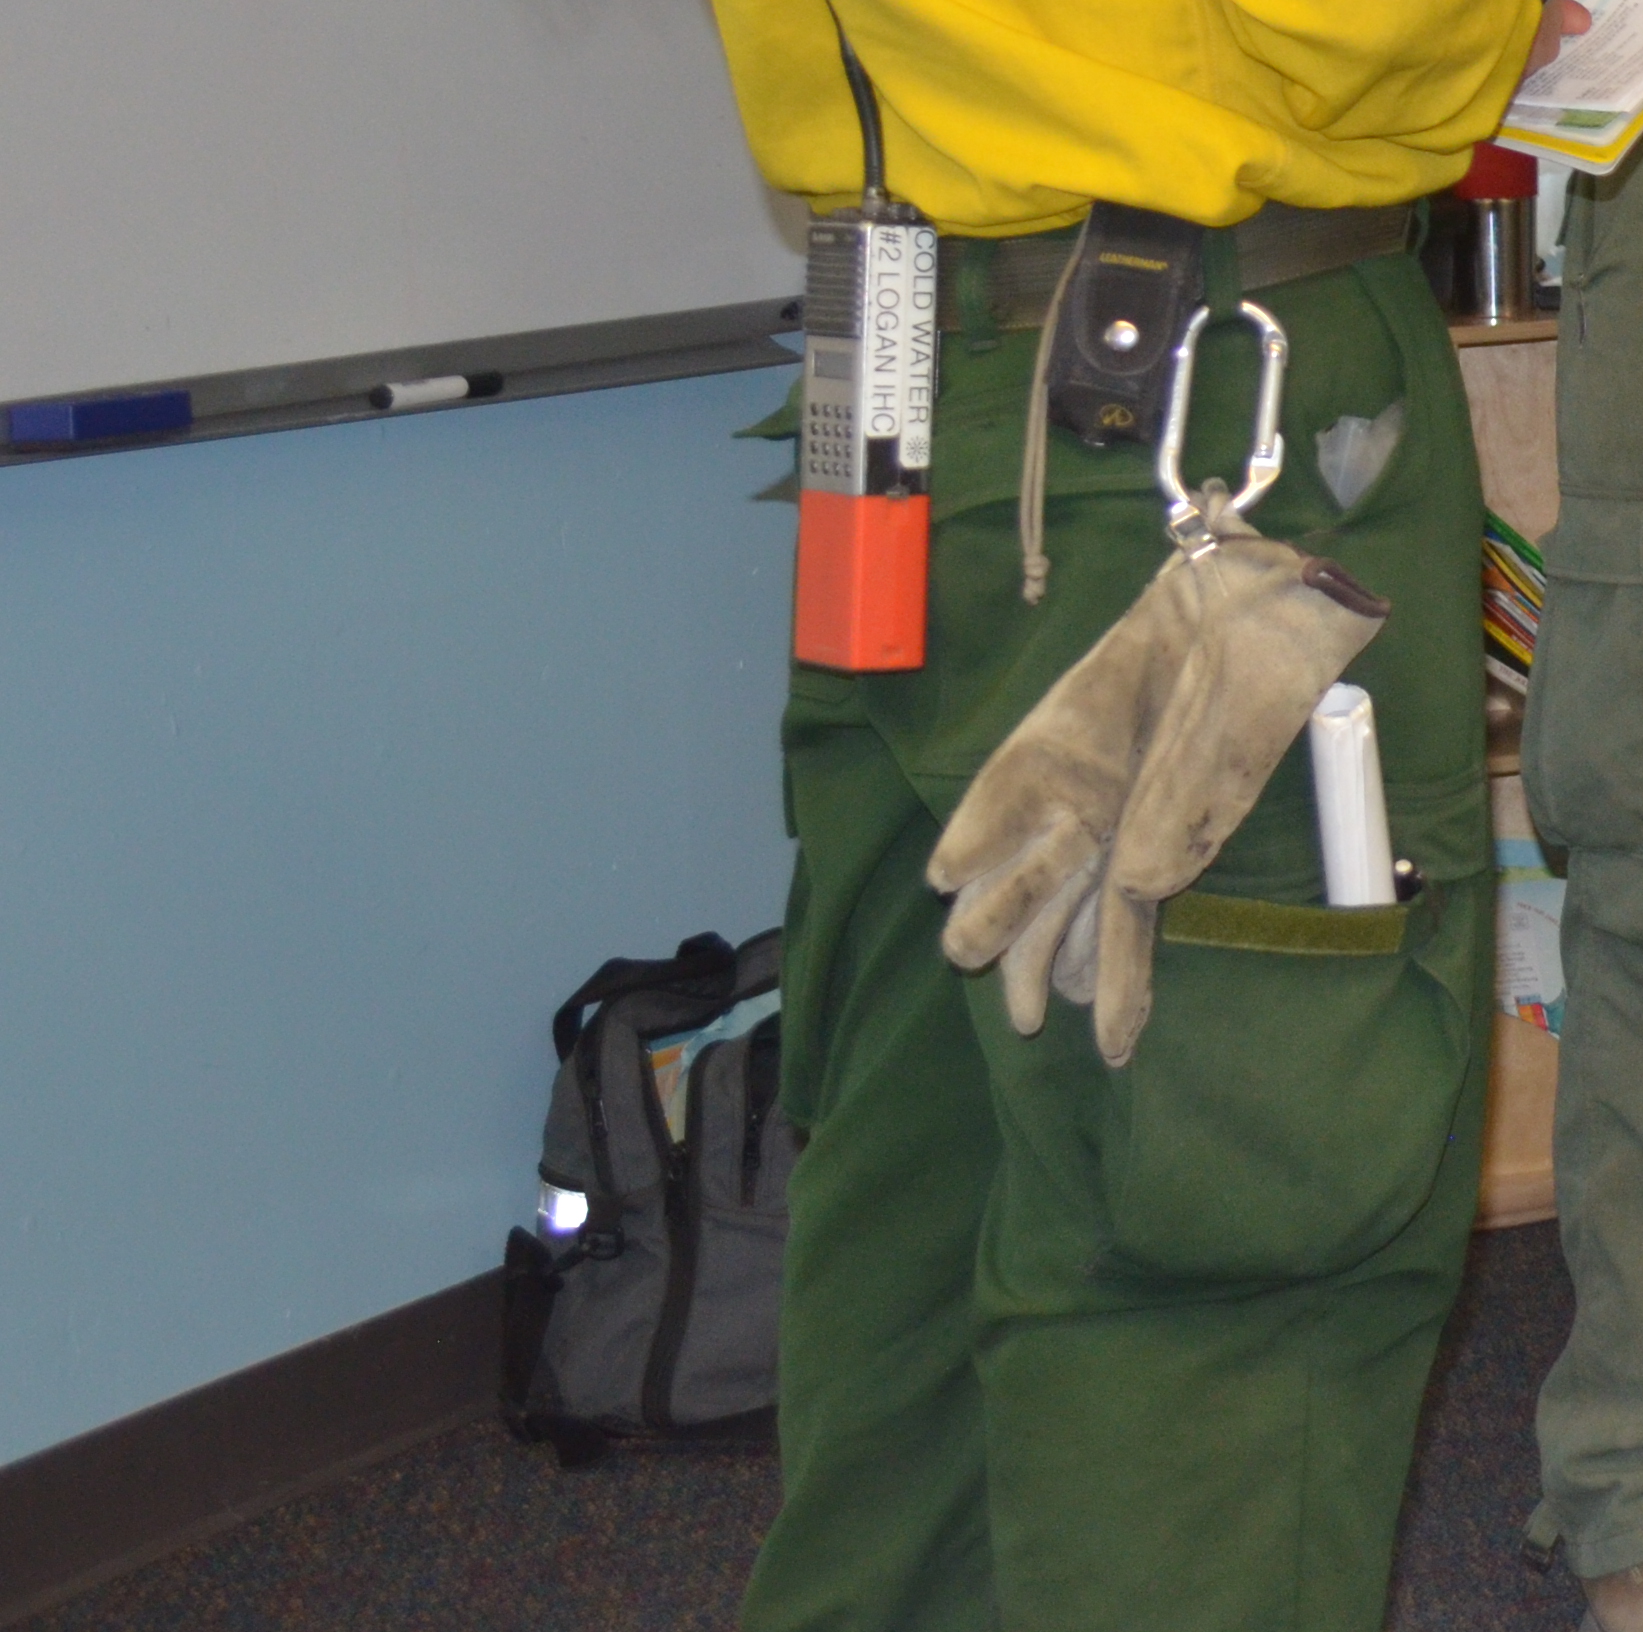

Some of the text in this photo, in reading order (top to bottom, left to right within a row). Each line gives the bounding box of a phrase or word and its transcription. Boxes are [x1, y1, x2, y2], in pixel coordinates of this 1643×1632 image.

[870, 230, 903, 433] #2 LOGAN IHC
[907, 229, 936, 424] COLD WATER
